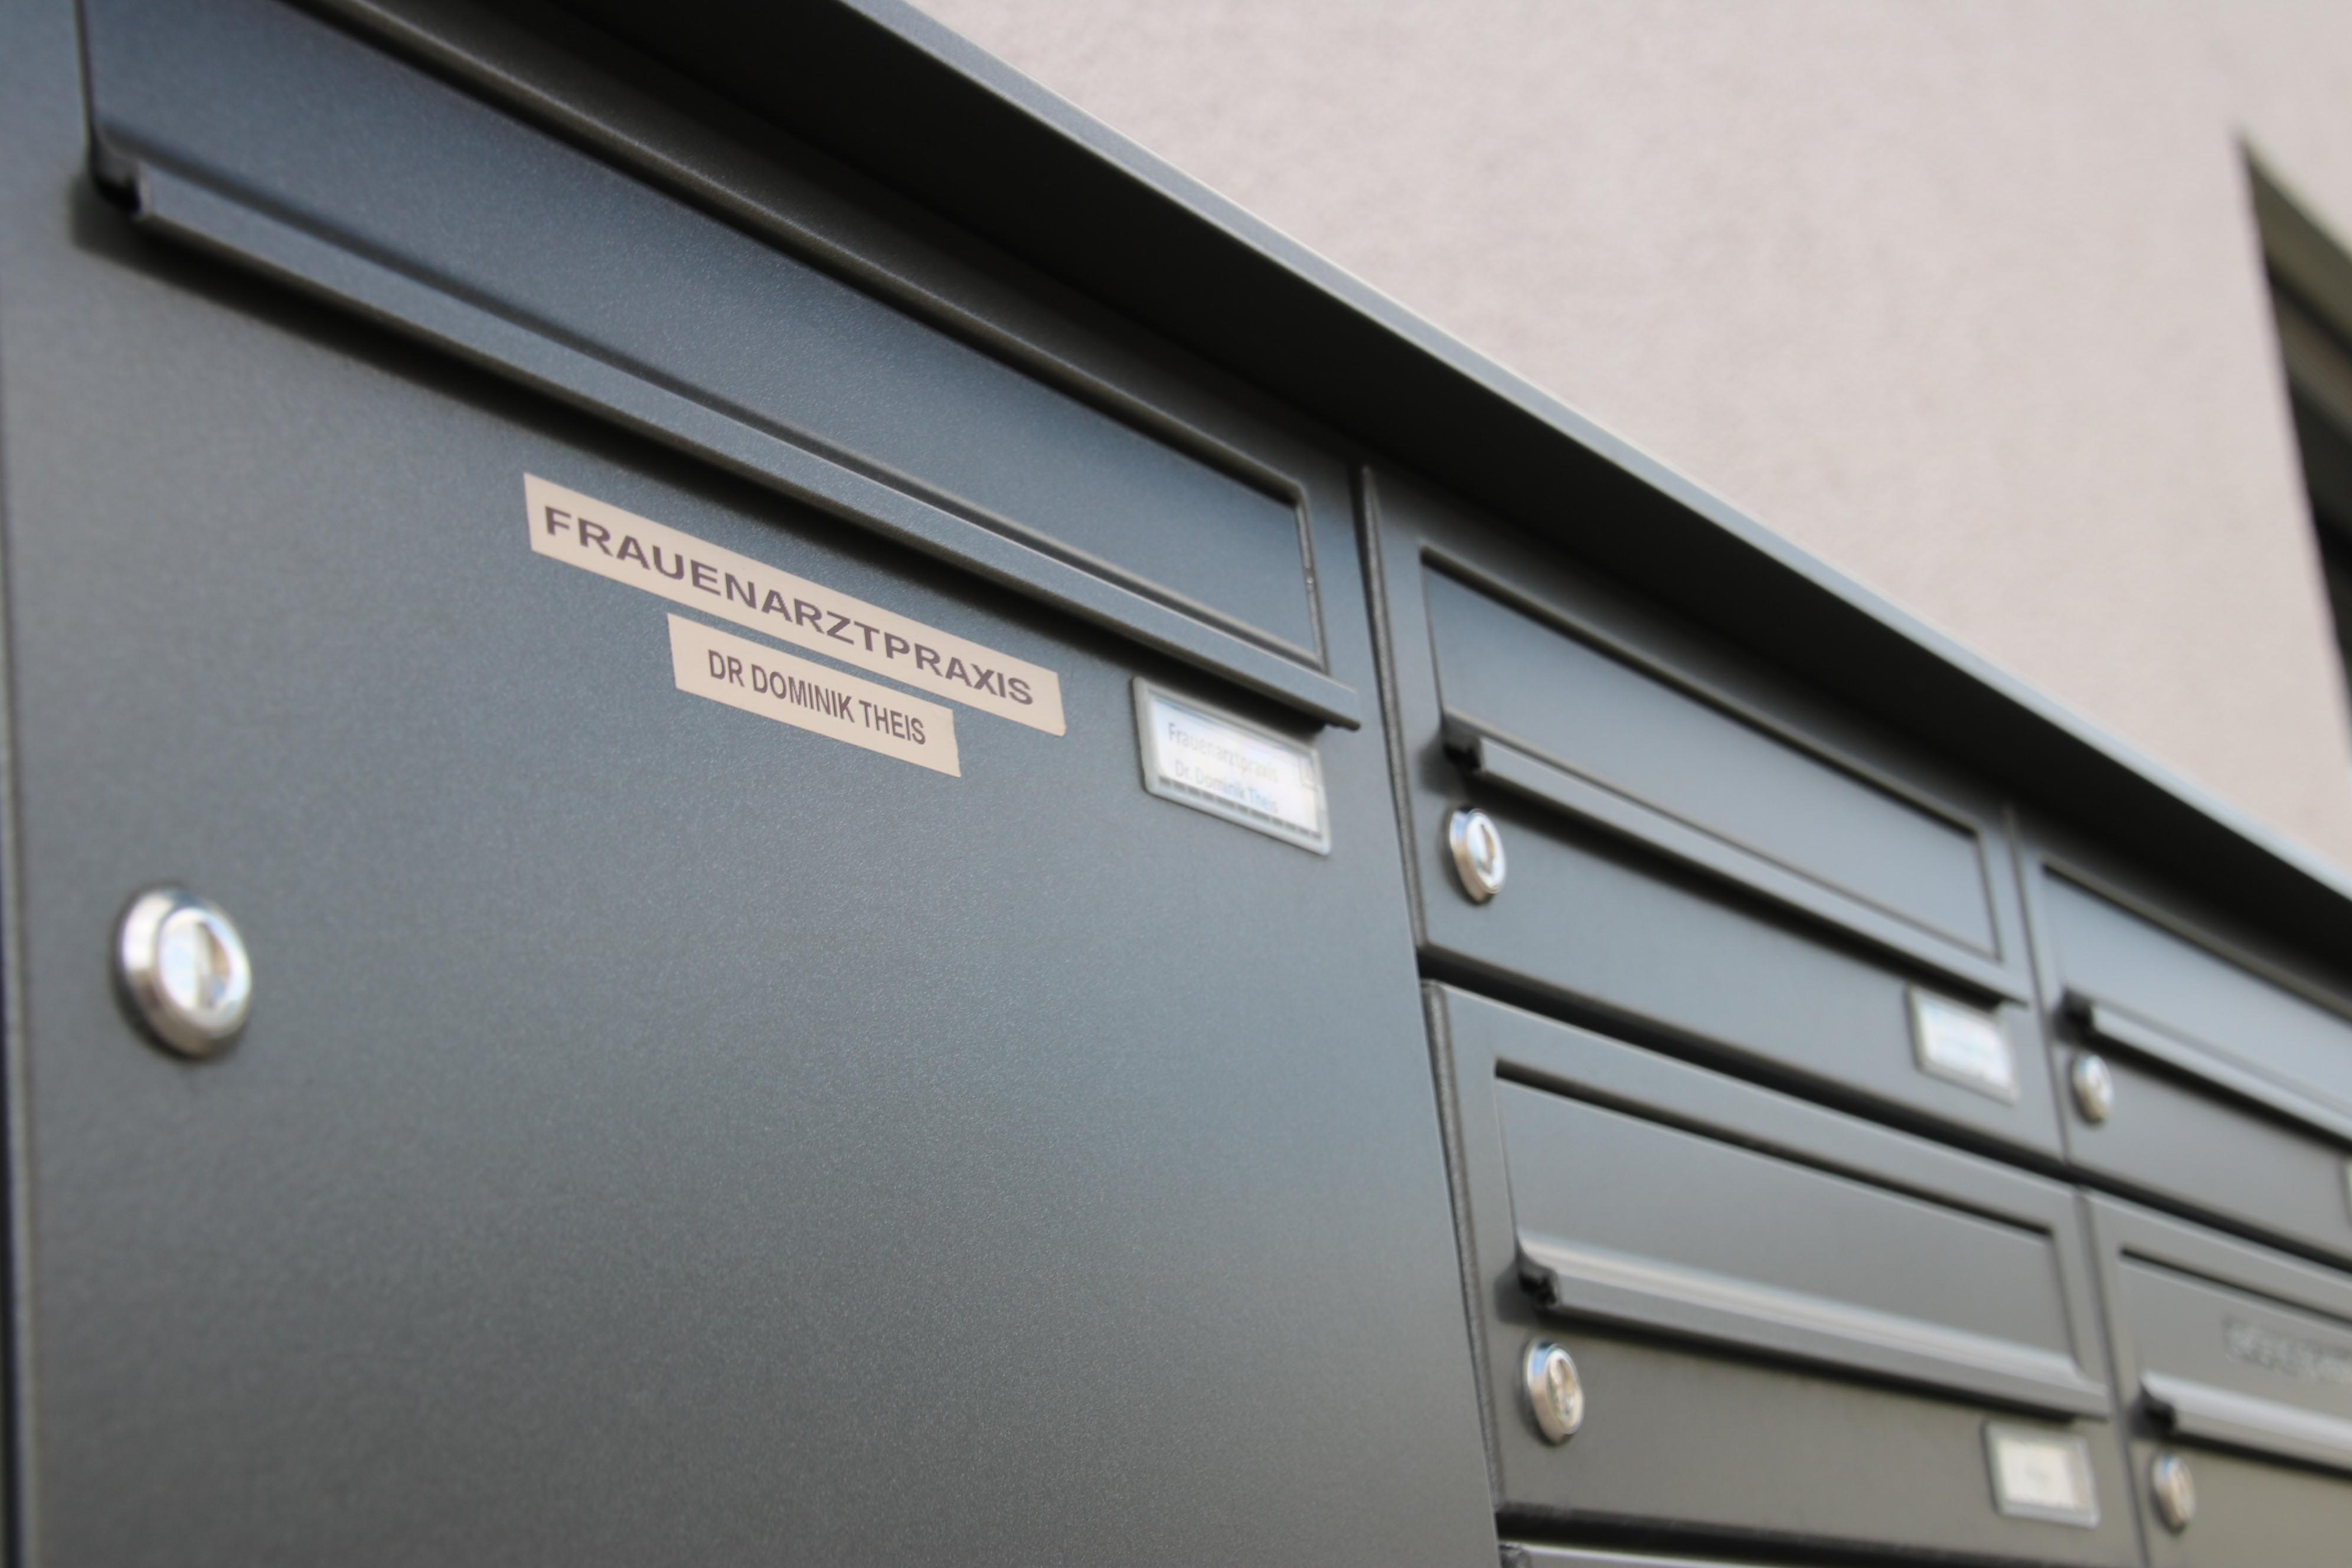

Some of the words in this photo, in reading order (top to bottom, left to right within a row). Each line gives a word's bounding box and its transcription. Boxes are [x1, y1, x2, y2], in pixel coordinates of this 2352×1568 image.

[544, 505, 1033, 705] FRAUENARZTPRAXIS
[708, 649, 744, 687] DR
[751, 664, 855, 723] DOMINIK
[859, 700, 926, 745] THEIS
